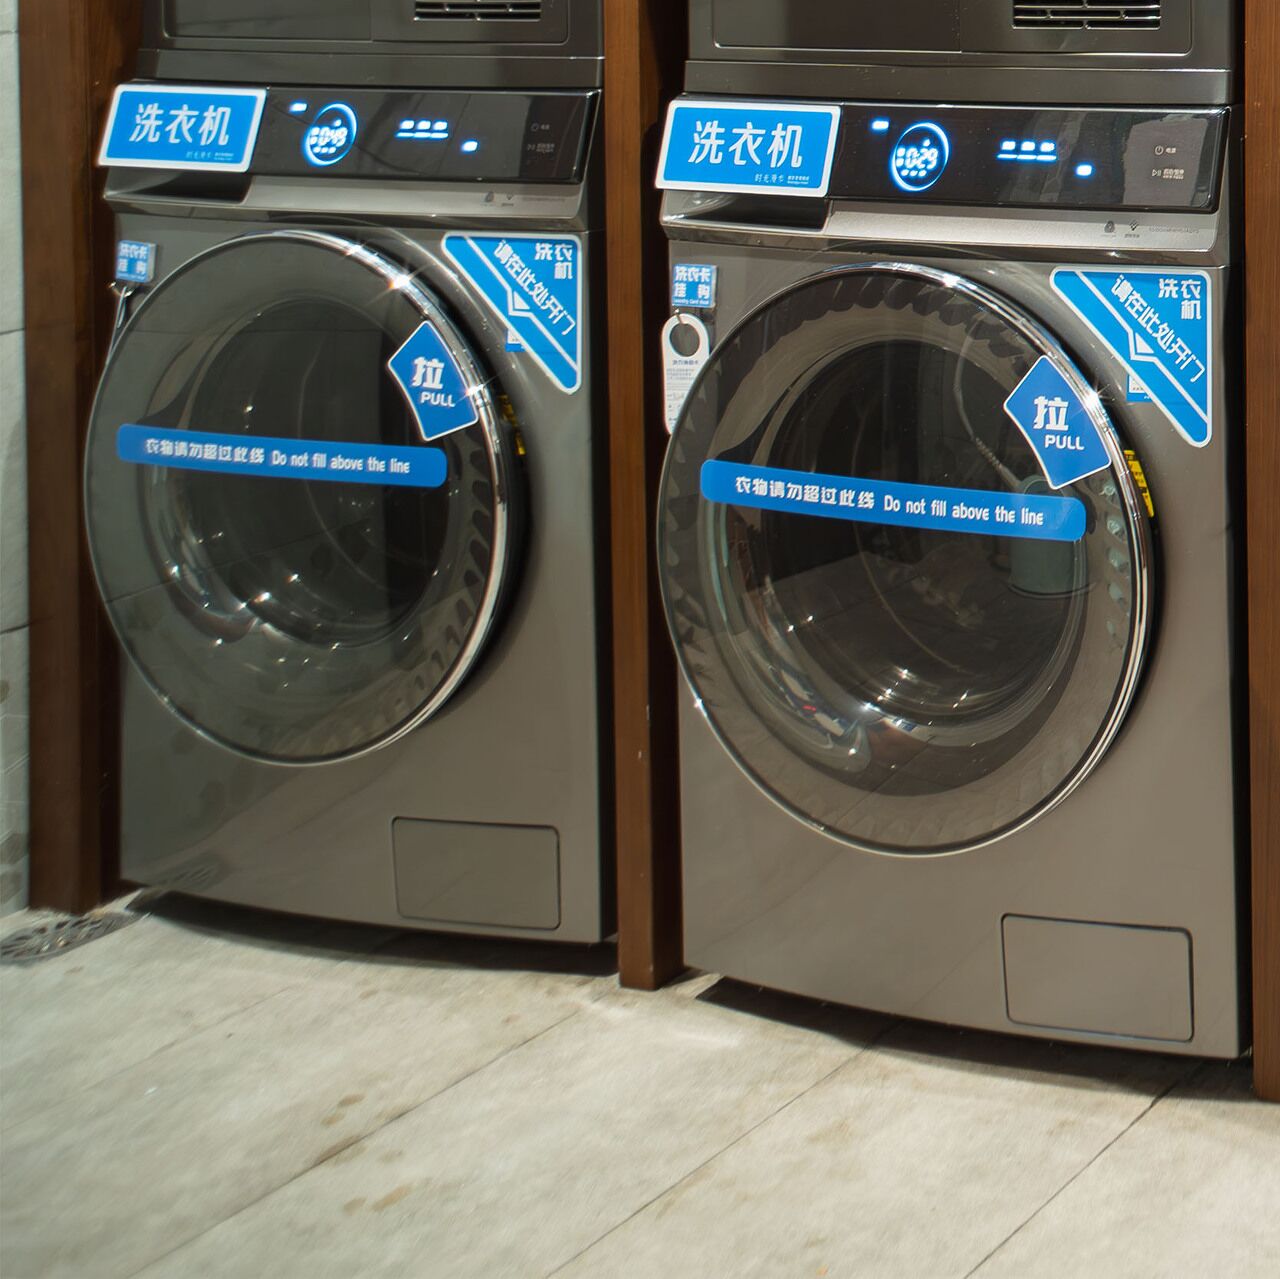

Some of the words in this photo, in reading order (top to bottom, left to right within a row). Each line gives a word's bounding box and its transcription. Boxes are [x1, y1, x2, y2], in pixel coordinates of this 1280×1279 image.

[129, 102, 231, 146] 洗衣机
[688, 120, 802, 168] 洗衣机
[534, 242, 573, 261] 洗衣
[493, 240, 576, 335] 请在此处开门
[675, 265, 711, 282] 洗衣卡
[1158, 278, 1201, 299] 洗衣
[1181, 300, 1201, 320] 机
[1111, 275, 1205, 382] 请在此处开门
[411, 356, 444, 389] 拉
[420, 391, 455, 407] PULL
[1033, 396, 1068, 431] 拉
[146, 438, 265, 464] 衣物请勿超过此线
[272, 450, 287, 465] Do
[290, 452, 308, 467] not
[312, 453, 327, 468] fill
[330, 454, 363, 470] above
[367, 456, 385, 472] the
[390, 458, 410, 473] line
[1045, 435, 1084, 450] PULL
[735, 476, 875, 509] 衣物请勿超过此线
[884, 495, 900, 511] Do
[906, 498, 926, 514] not
[931, 500, 947, 517] fill
[952, 502, 989, 521] above
[995, 506, 1015, 523] the
[1021, 508, 1044, 525] line
